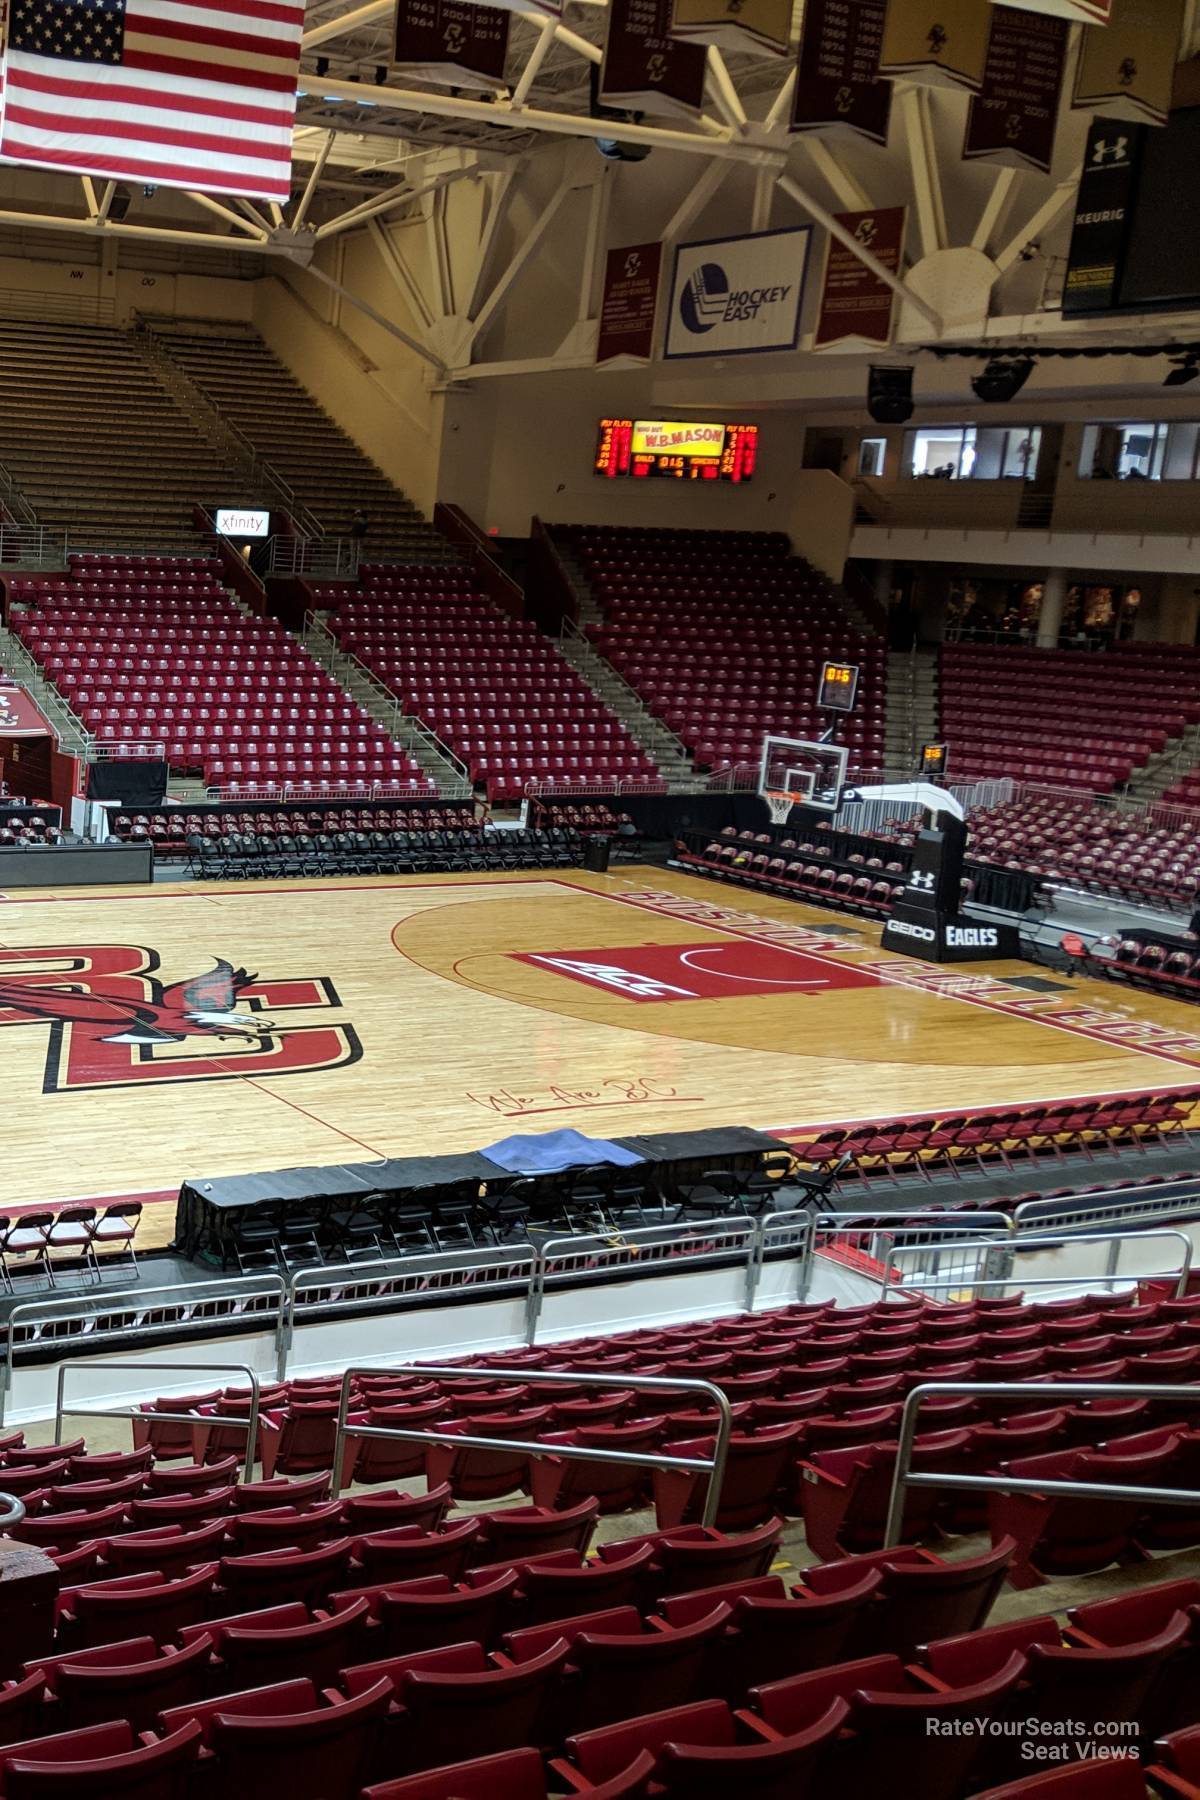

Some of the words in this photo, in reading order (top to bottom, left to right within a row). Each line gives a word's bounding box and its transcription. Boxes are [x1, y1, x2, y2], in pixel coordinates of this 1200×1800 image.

[406, 15, 434, 28] 1964
[442, 8, 472, 22] 2004
[474, 30, 501, 40] 2016
[624, 22, 655, 34] 2001
[643, 37, 673, 50] 2012
[1076, 209, 1125, 224] KEURIG
[70, 270, 84, 279] NN
[728, 285, 792, 307] HOCKEY
[722, 304, 760, 322] EAST
[556, 484, 565, 494] P
[768, 493, 777, 502] P
[222, 515, 263, 534] xfinity
[615, 890, 868, 951] BOSTON
[887, 919, 935, 941] GEICO
[550, 957, 701, 997] ACC
[466, 1088, 533, 1112] We
[550, 1085, 600, 1105] Are
[603, 1077, 676, 1100] BC
